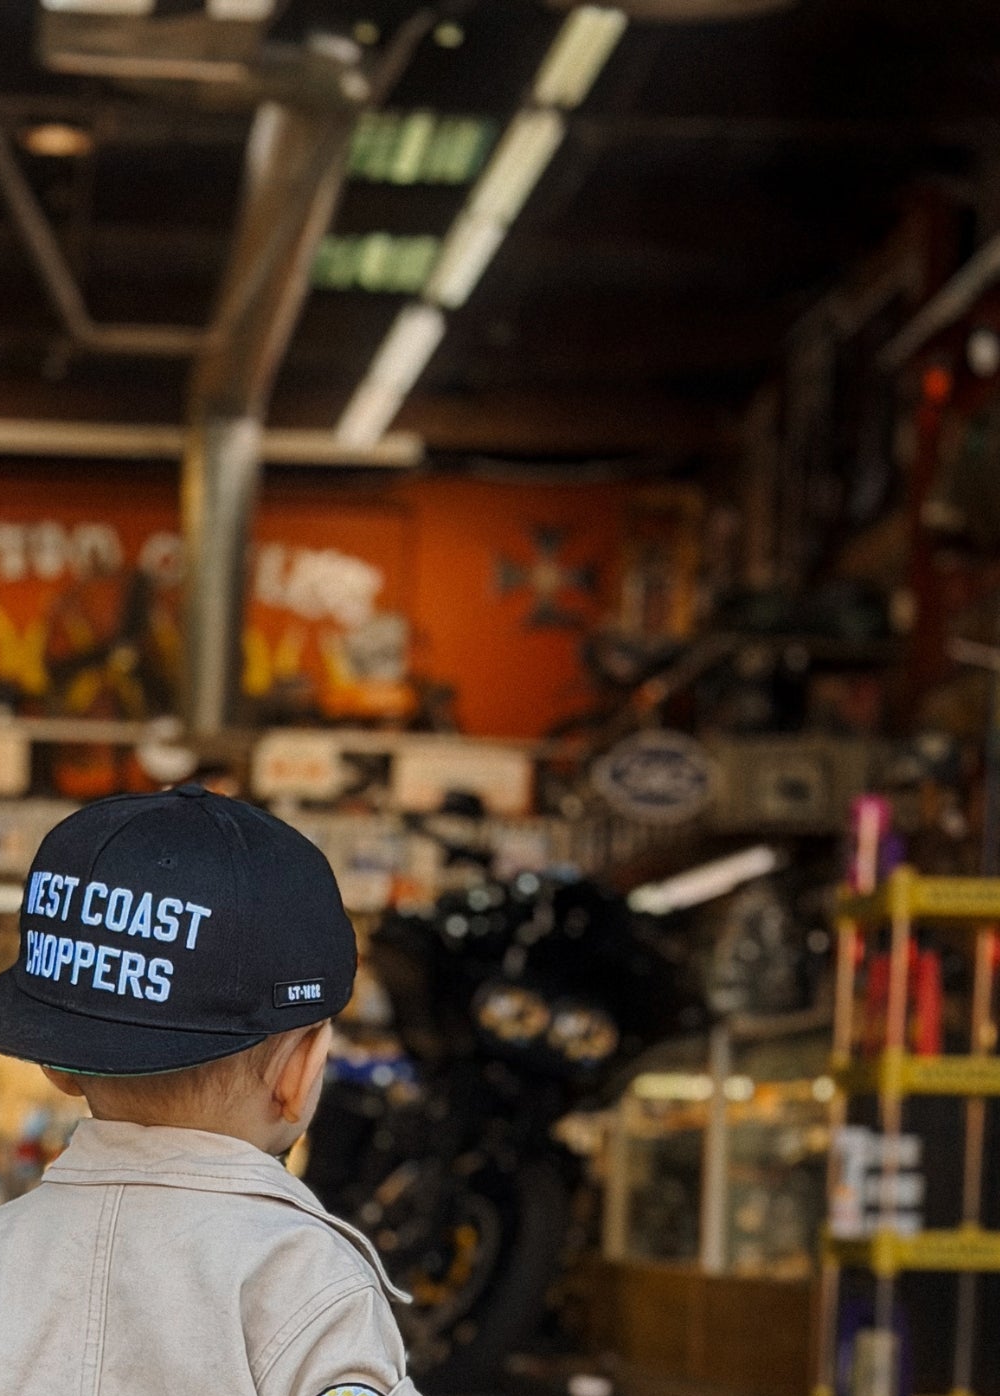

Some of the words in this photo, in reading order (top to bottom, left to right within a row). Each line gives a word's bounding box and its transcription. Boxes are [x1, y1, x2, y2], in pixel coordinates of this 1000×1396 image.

[27, 871, 80, 921] WEST
[81, 881, 212, 949] COAST
[25, 929, 174, 1002] CHOPPERS
